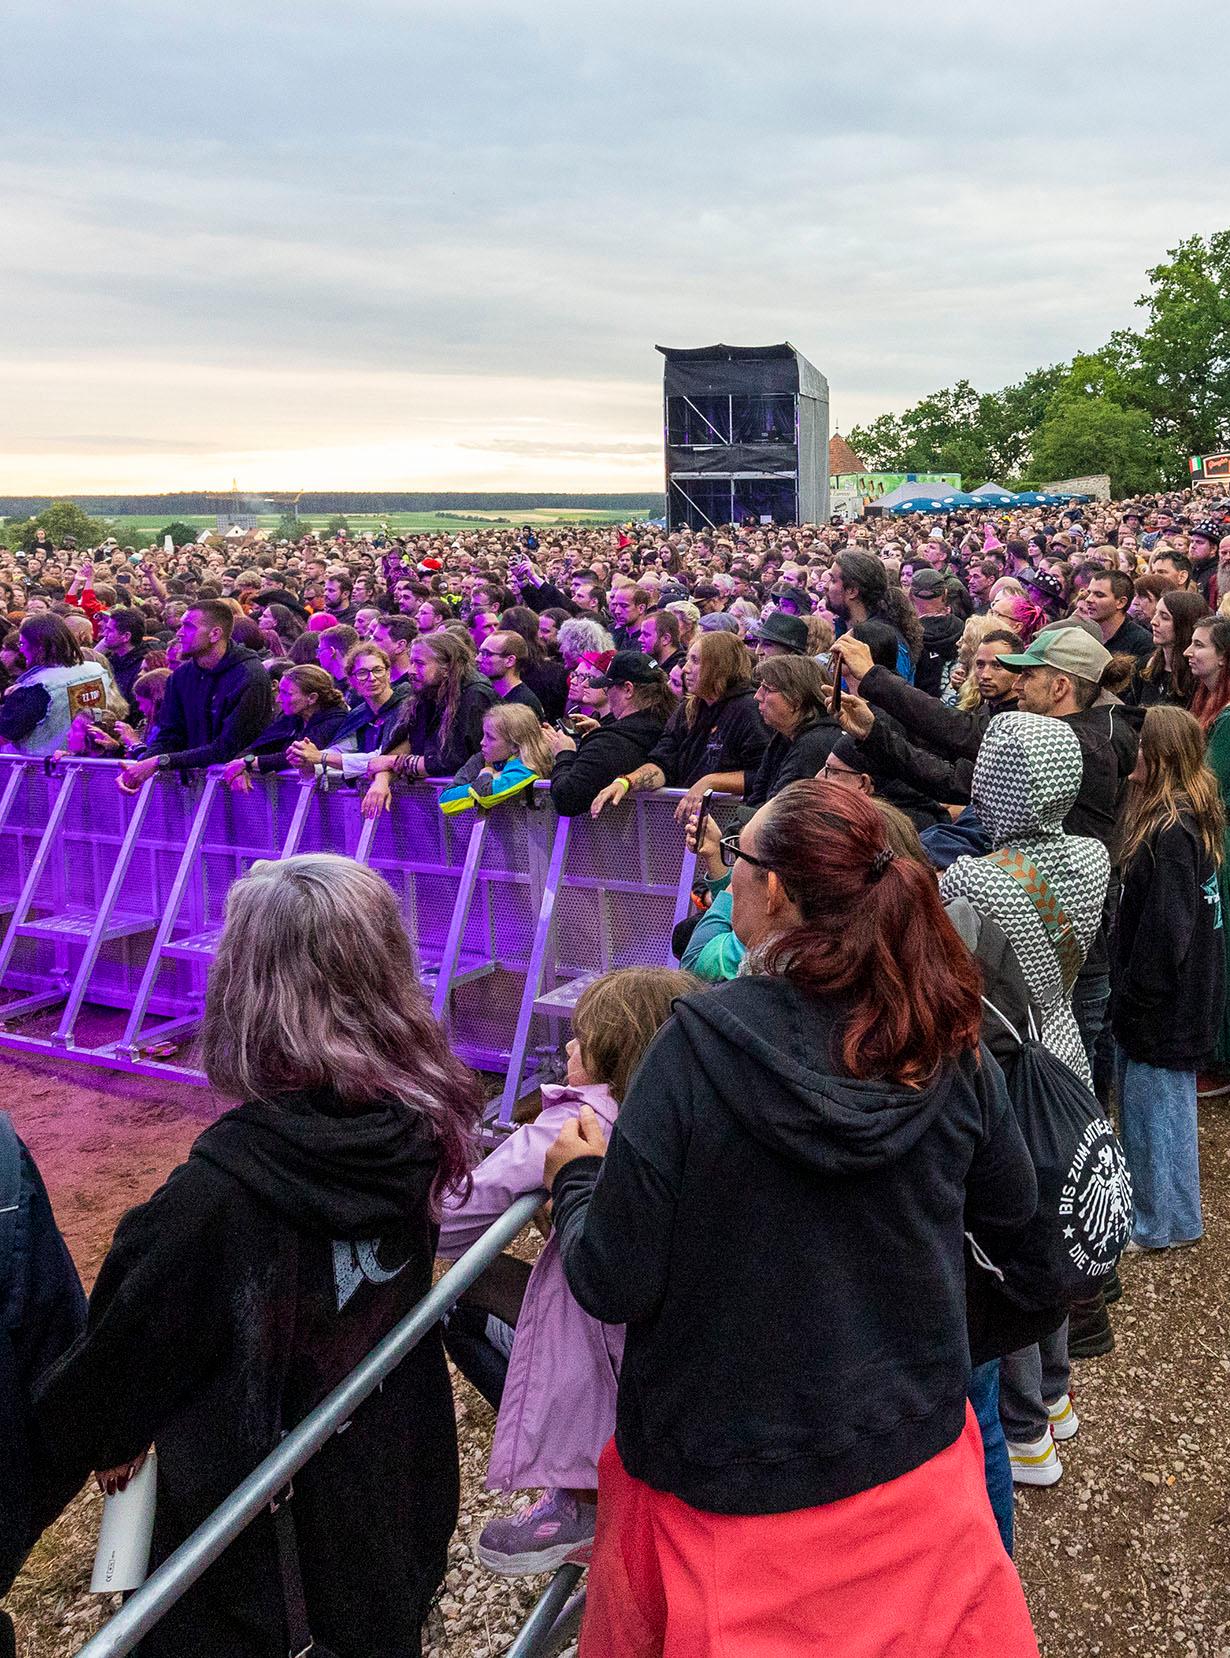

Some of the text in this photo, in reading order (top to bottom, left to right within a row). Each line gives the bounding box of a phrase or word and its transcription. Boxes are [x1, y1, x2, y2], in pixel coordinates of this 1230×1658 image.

[82, 692, 90, 703] ZZ
[1067, 1142, 1091, 1184] ZUM
[1058, 1184, 1077, 1215] BIS
[1068, 1242, 1090, 1270] DIE
